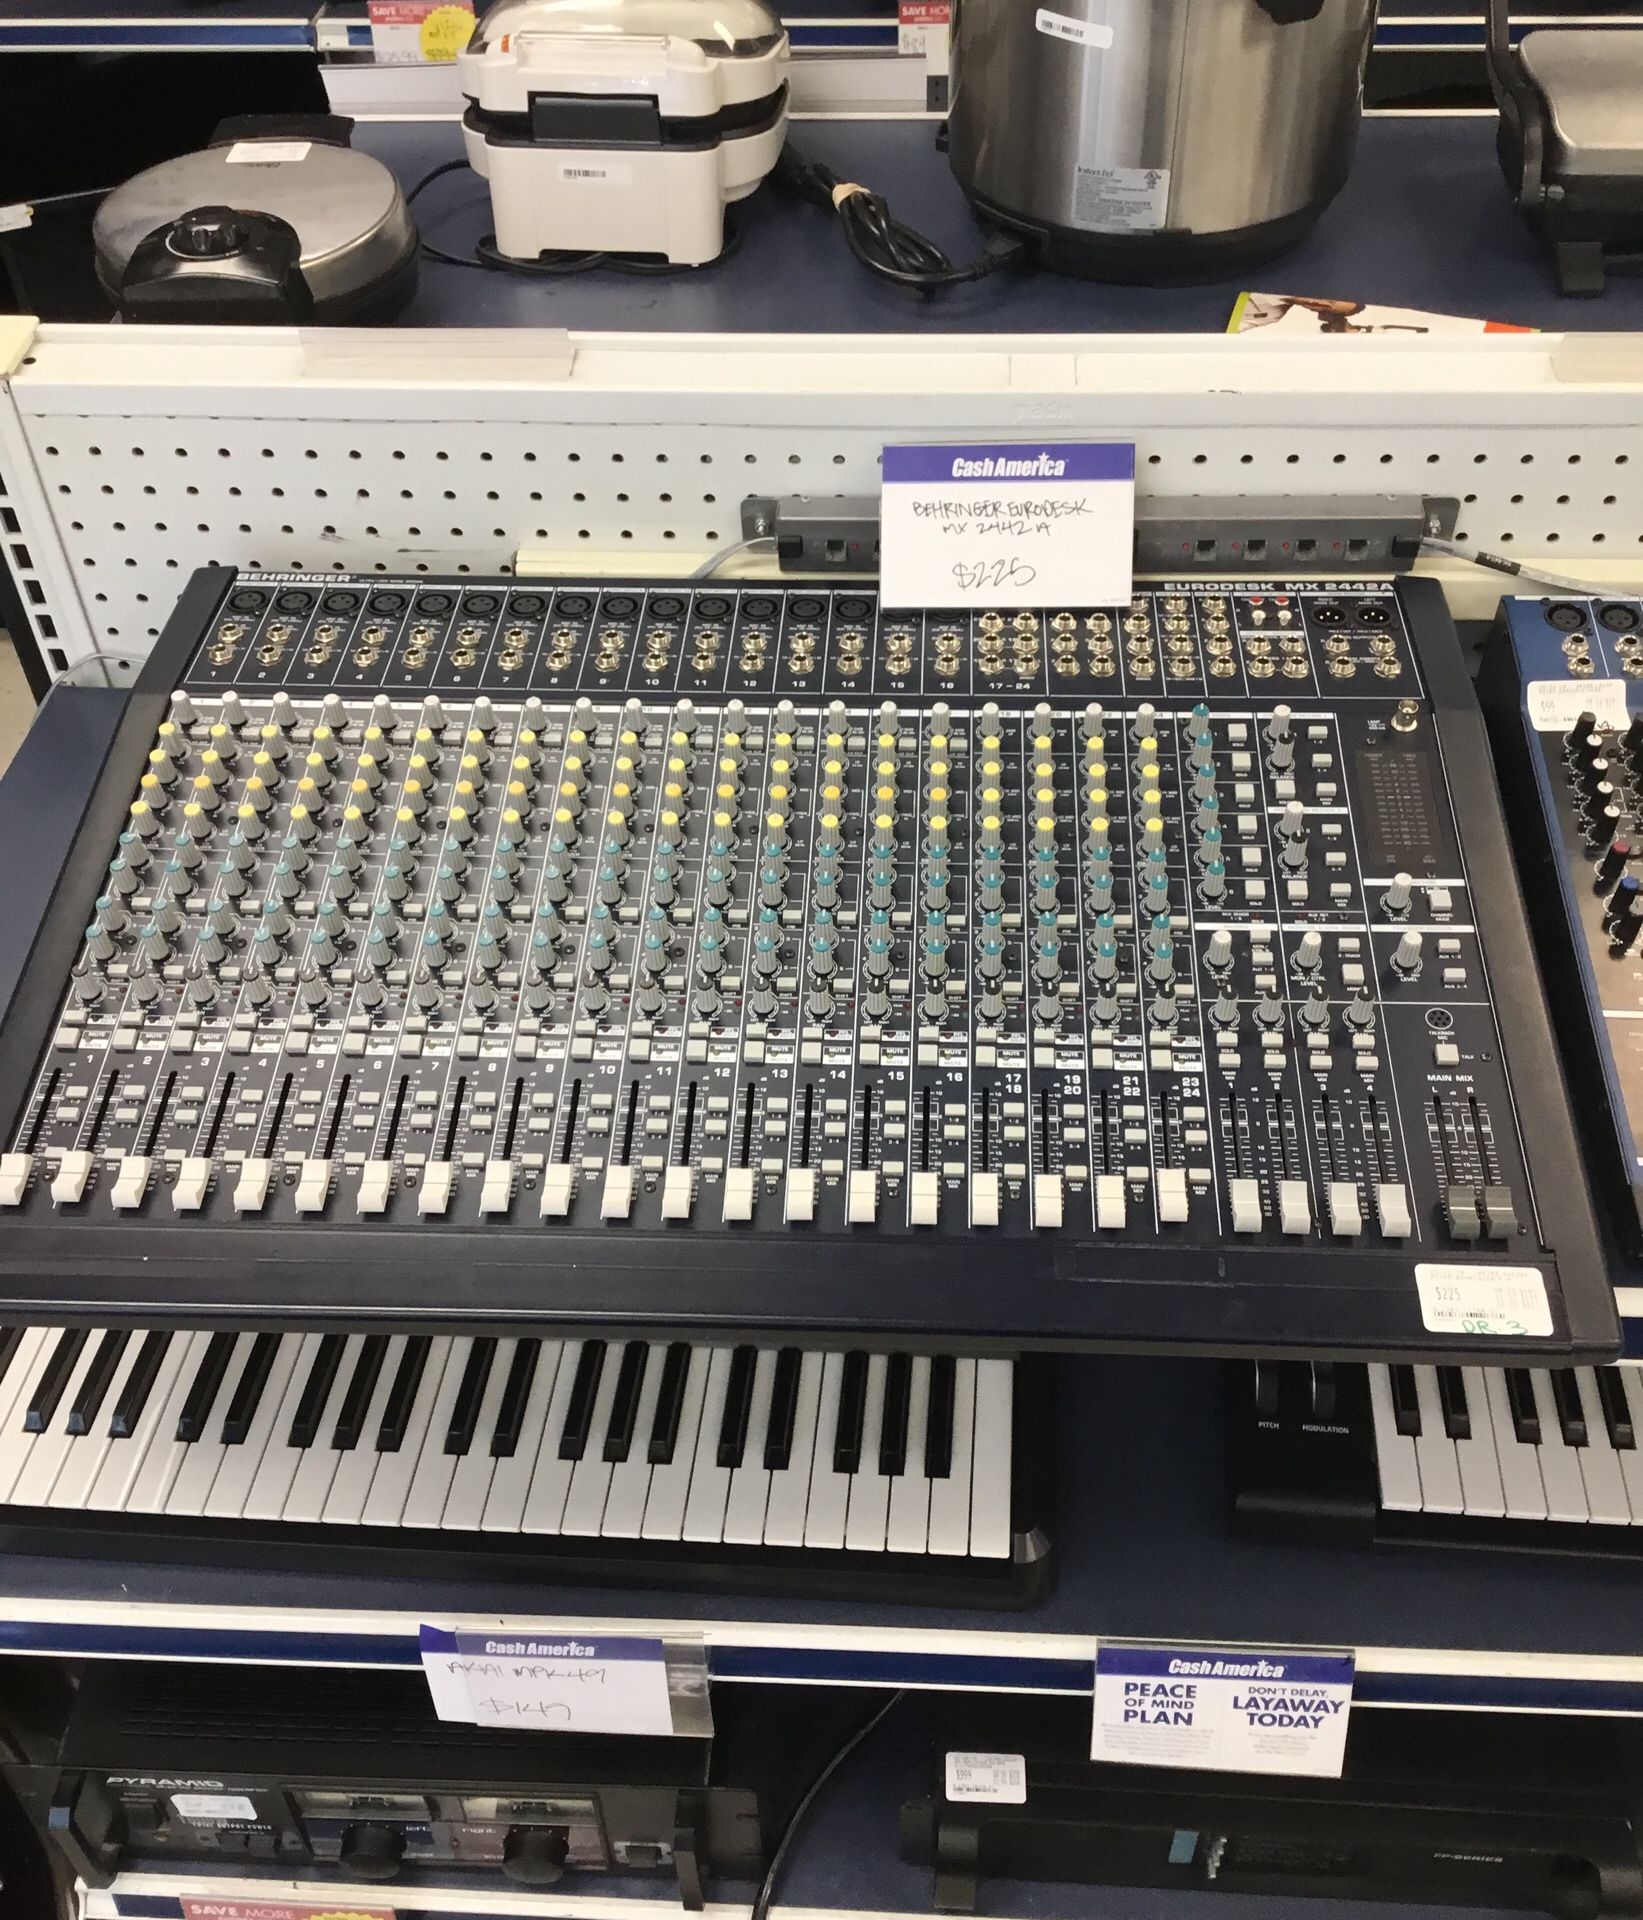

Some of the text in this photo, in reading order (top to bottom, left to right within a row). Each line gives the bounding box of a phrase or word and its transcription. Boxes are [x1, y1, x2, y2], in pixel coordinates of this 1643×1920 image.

[372, 6, 396, 16] SAVE
[902, 6, 926, 16] SAVE
[912, 498, 1094, 518] BEHRINGER EURODESK
[942, 522, 968, 535] MX
[236, 572, 351, 583] BEHRINGER
[952, 557, 1036, 592] $225
[1164, 582, 1395, 592] EURODESK MX 2442A
[86, 1054, 94, 1063] 1
[142, 1056, 152, 1065] 2
[200, 1057, 210, 1066] 3
[258, 1058, 268, 1067] 4
[316, 1060, 325, 1069] 5
[373, 1060, 382, 1070] 6
[431, 1061, 440, 1071] 7
[487, 1062, 497, 1072] 8
[545, 1064, 554, 1073] 9
[599, 1065, 616, 1075] 10
[656, 1066, 673, 1076] 11
[714, 1067, 731, 1078] 12
[771, 1068, 789, 1079] 13
[829, 1070, 847, 1080] 14
[887, 1071, 905, 1081] 15
[946, 1072, 963, 1082] 16
[1005, 1073, 1022, 1083] 17
[1064, 1074, 1081, 1084] 19
[1122, 1076, 1139, 1086] 21
[1427, 1074, 1452, 1082] MAIN
[1182, 1077, 1200, 1087] 23
[1005, 1084, 1022, 1094] 18
[1063, 1085, 1082, 1095] 20
[1123, 1086, 1141, 1096] 22
[1182, 1087, 1201, 1098] 24
[1435, 1286, 1461, 1301] $225
[1258, 1421, 1280, 1430] PITCH
[1302, 1424, 1349, 1434] MODULATION
[1123, 1682, 1198, 1699] PEACE
[1248, 1686, 1288, 1697] DON'T
[1124, 1697, 1195, 1710] OF MIND
[1232, 1695, 1346, 1714] LAYAWAY
[1123, 1709, 1194, 1726] PLAN
[1246, 1711, 1326, 1729] TODAY
[106, 1776, 225, 1788] PYRAMID
[190, 1905, 296, 1919] SAVE MORE
